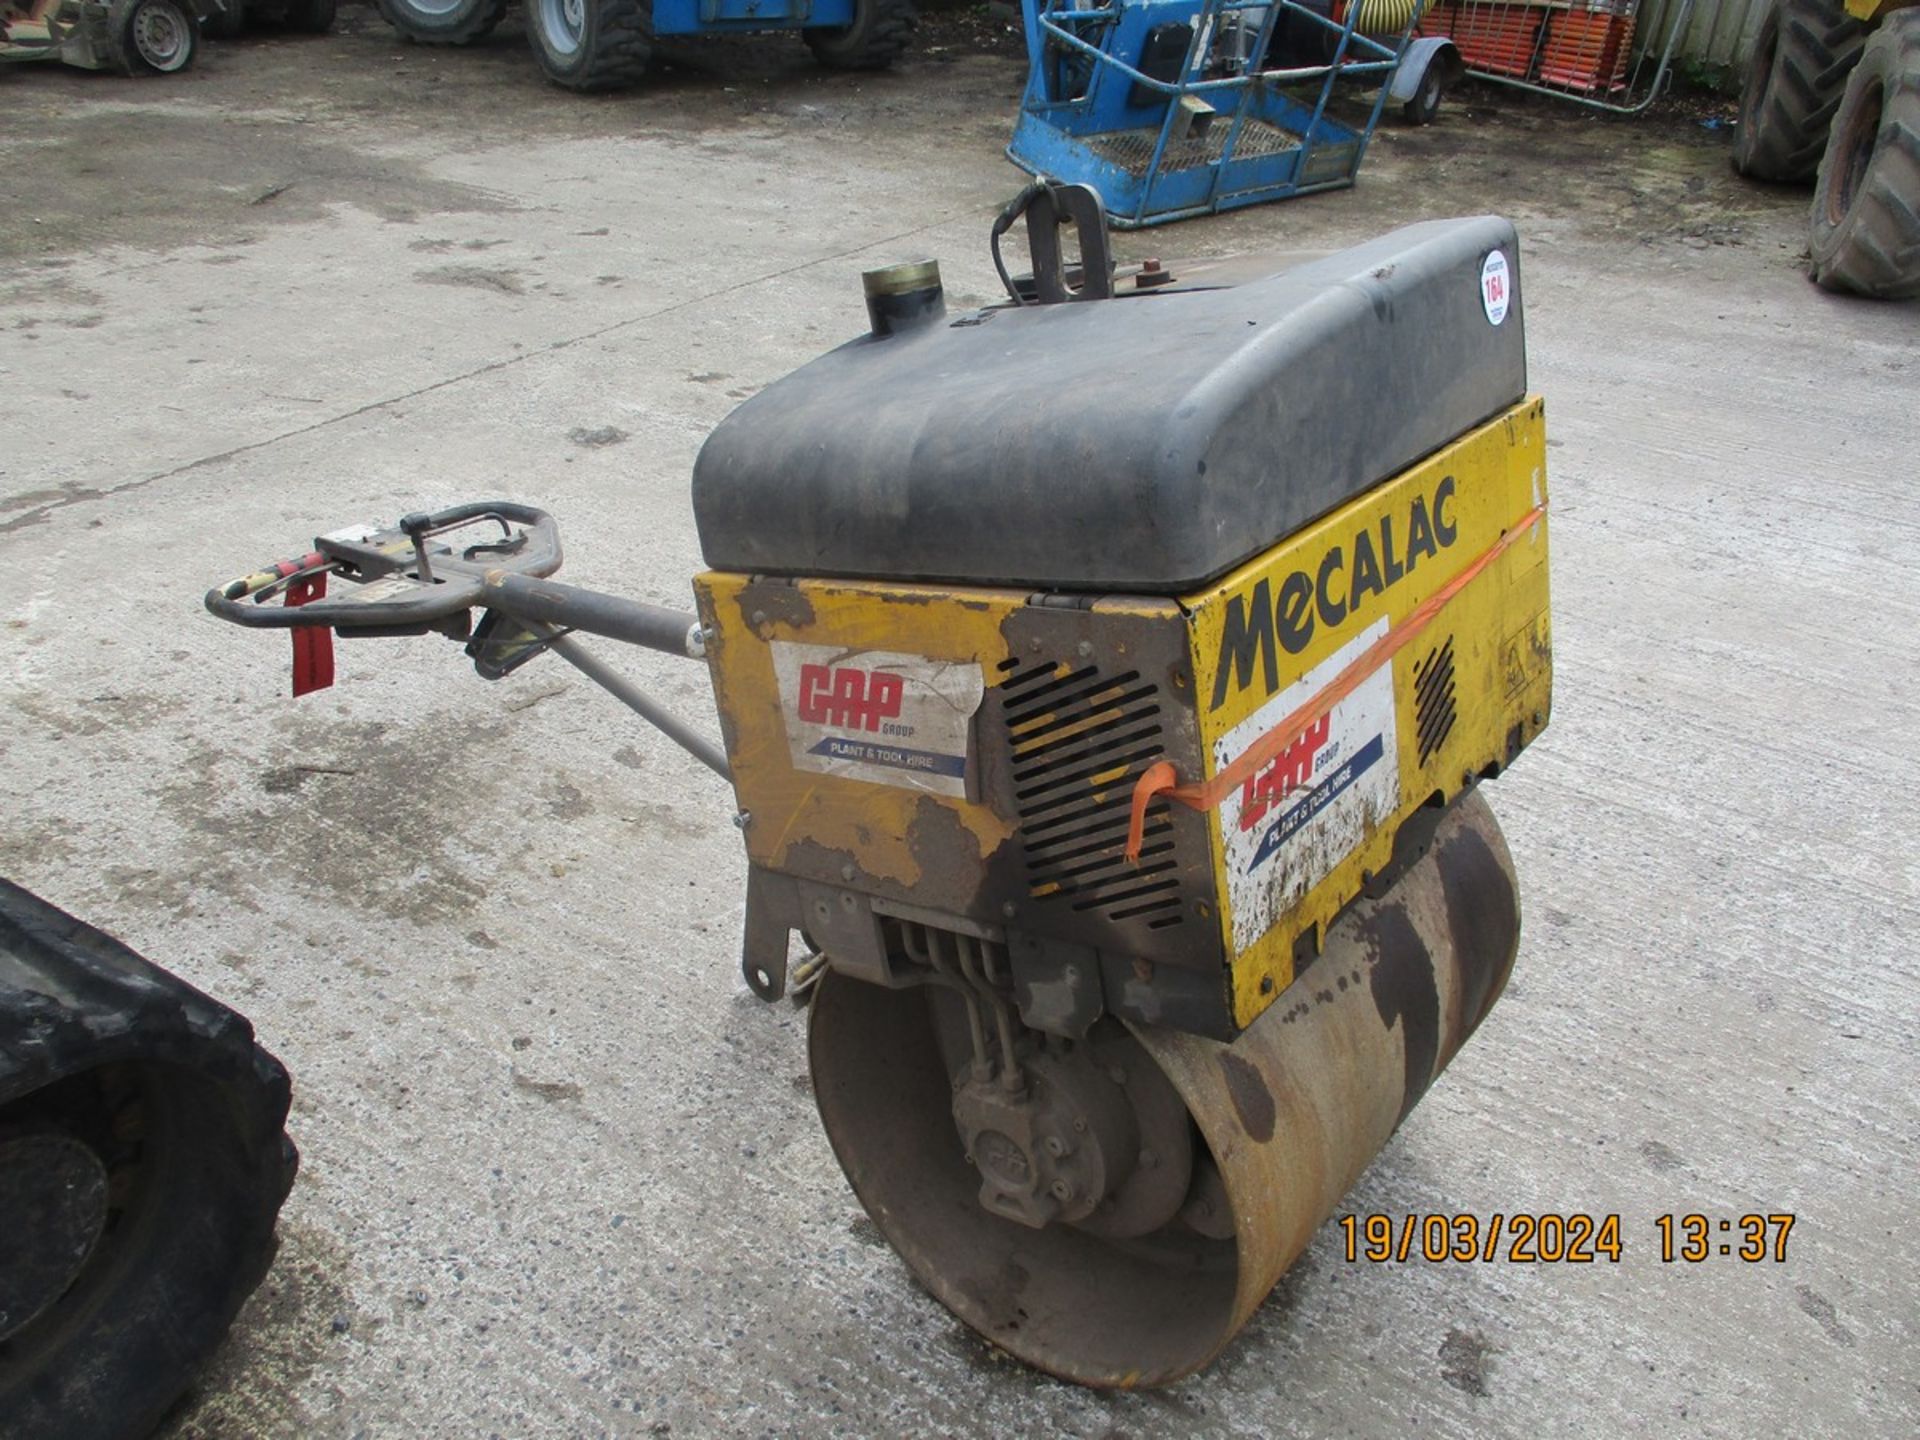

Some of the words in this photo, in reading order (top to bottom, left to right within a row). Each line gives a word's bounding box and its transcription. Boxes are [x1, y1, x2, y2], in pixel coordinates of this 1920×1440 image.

[1486, 275, 1503, 304] 164
[798, 663, 904, 732] GAP
[882, 722, 915, 738] GROUP
[830, 742, 865, 757] PLANT
[866, 747, 875, 760] &
[876, 749, 902, 763] TOOL
[907, 755, 934, 769] HIRE
[1268, 812, 1301, 848] PLANT
[1300, 799, 1308, 820] &
[1332, 765, 1352, 792] HIRE
